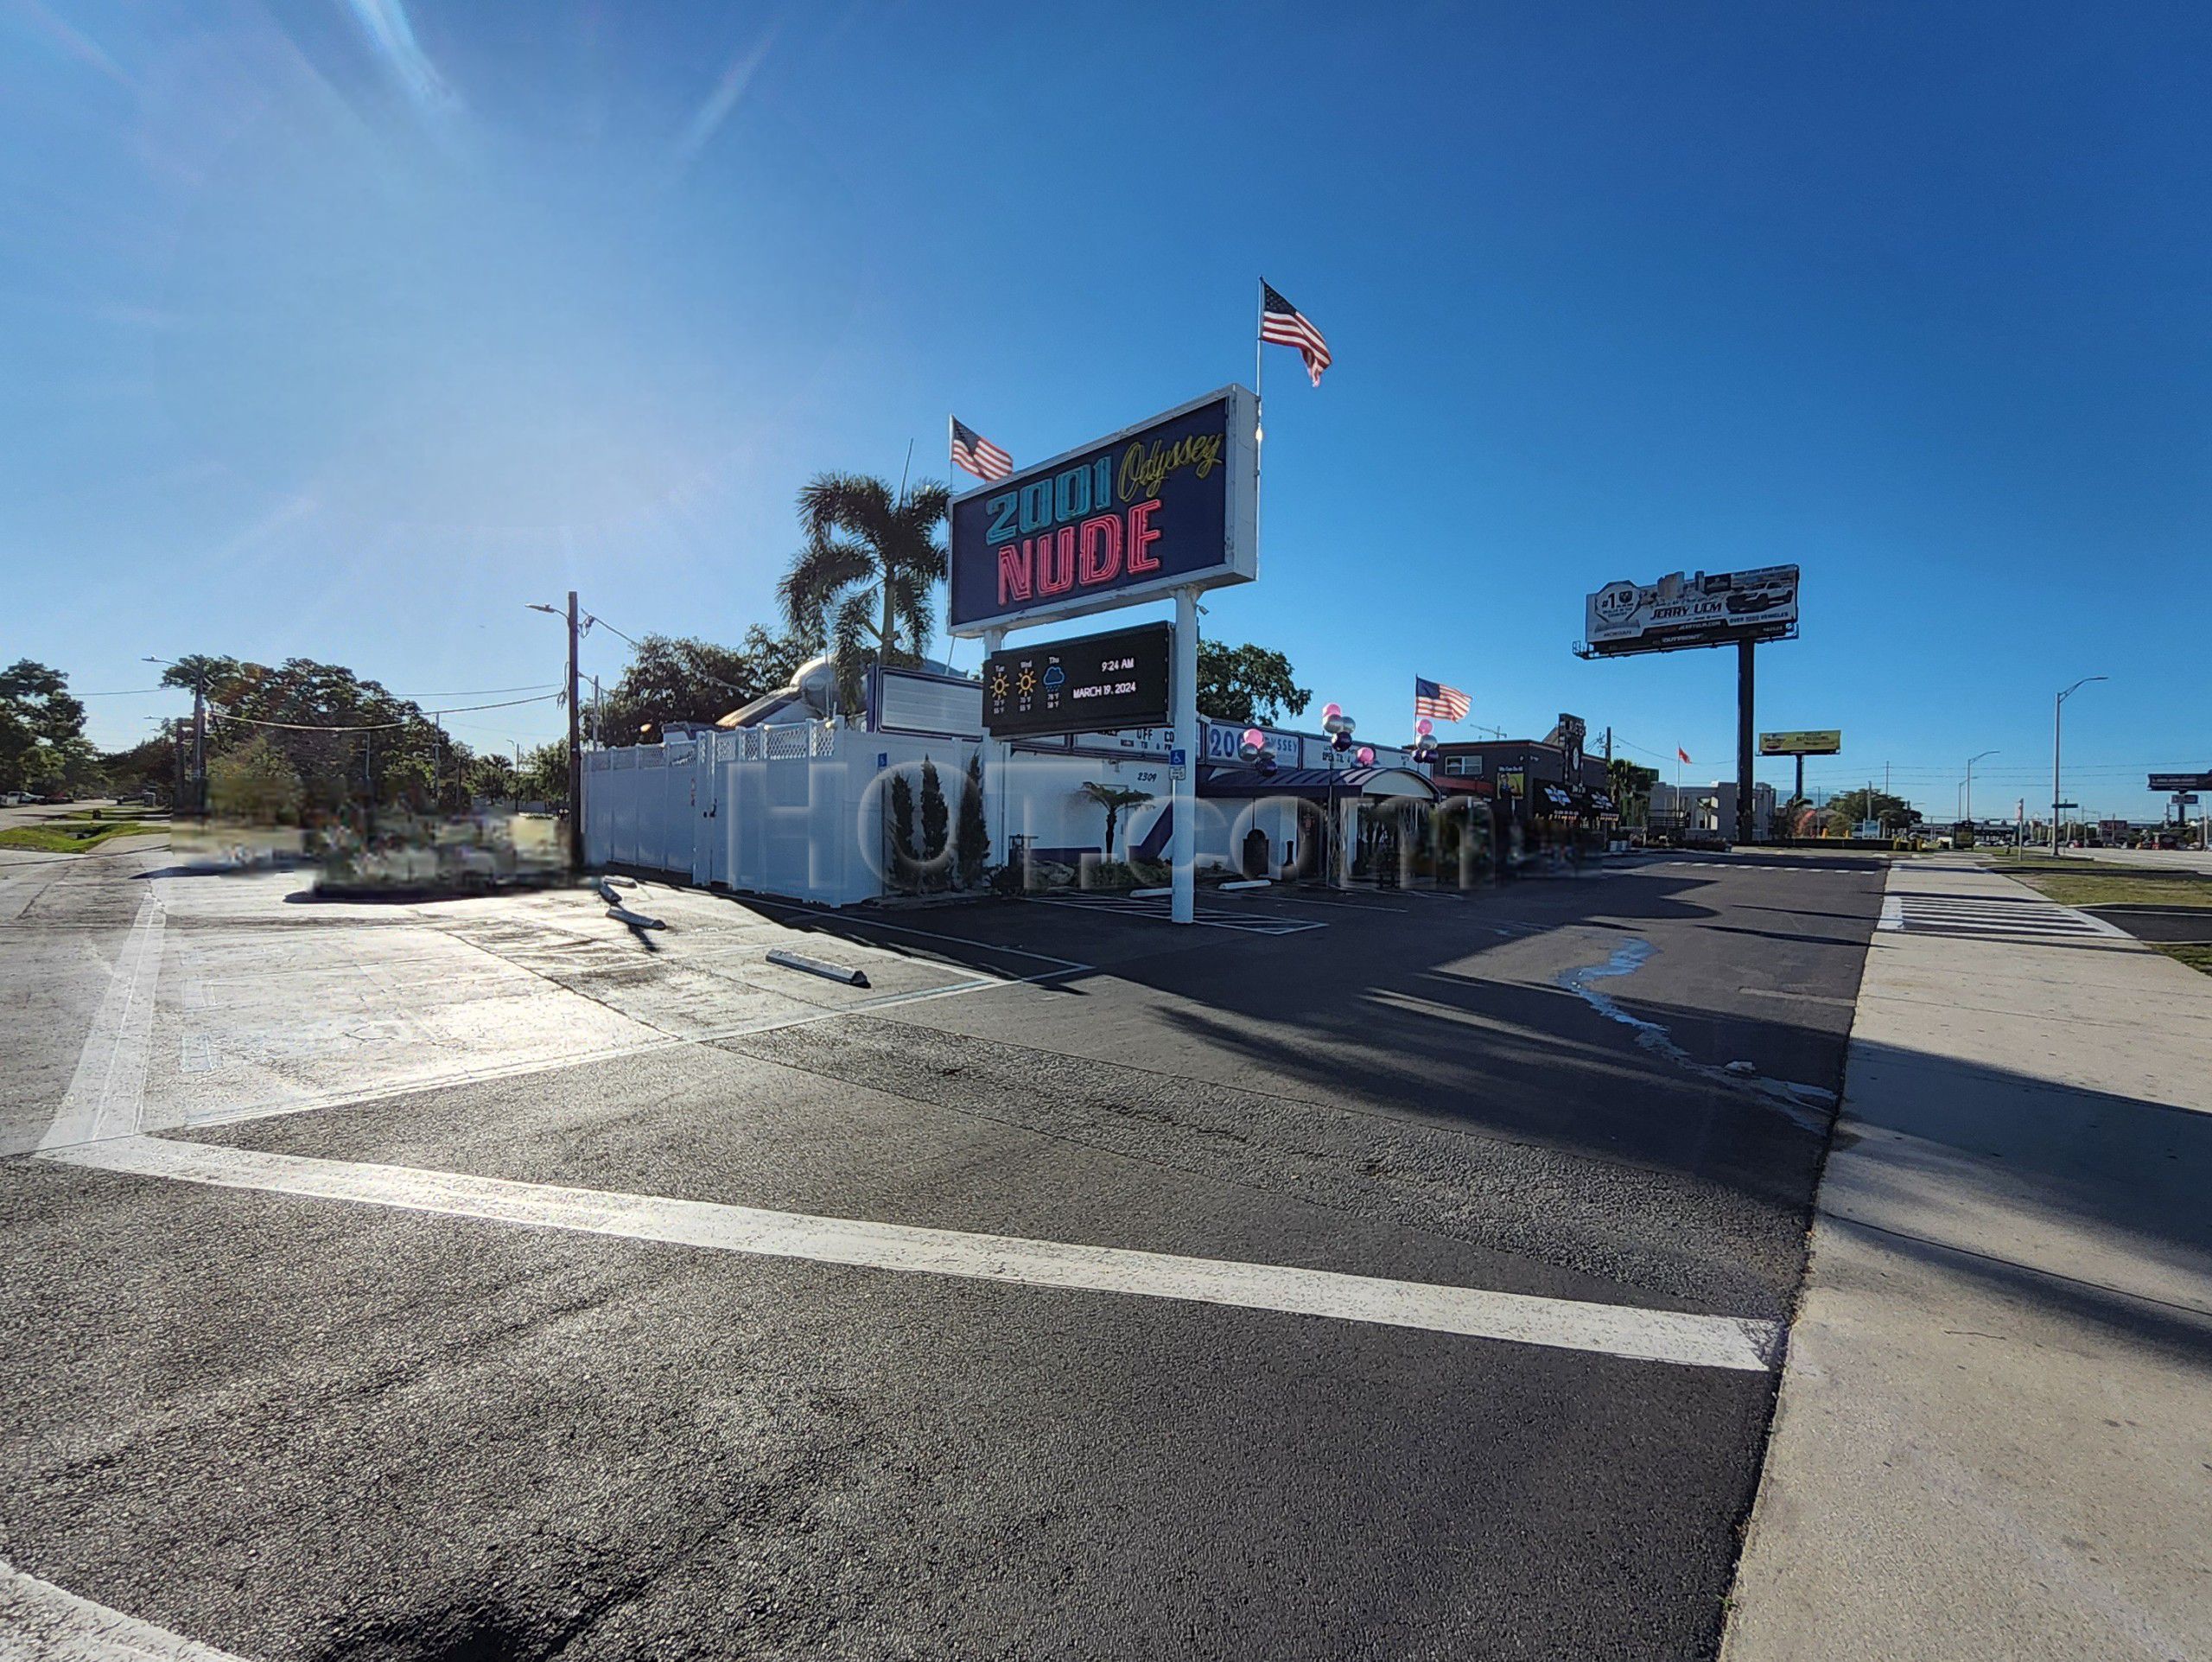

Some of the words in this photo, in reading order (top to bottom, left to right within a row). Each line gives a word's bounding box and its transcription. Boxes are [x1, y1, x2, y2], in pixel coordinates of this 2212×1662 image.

[985, 455, 1113, 546] 2001
[1117, 433, 1224, 502] Odyssey
[998, 499, 1162, 607] NUDE
[1649, 606, 1690, 620] JERRY
[1694, 602, 1722, 614] ULM
[1101, 659, 1120, 672] 9:24
[1121, 657, 1135, 670] AM
[1072, 685, 1103, 699] MARCH
[1115, 681, 1137, 695] 2024
[1137, 772, 1158, 783] 2309
